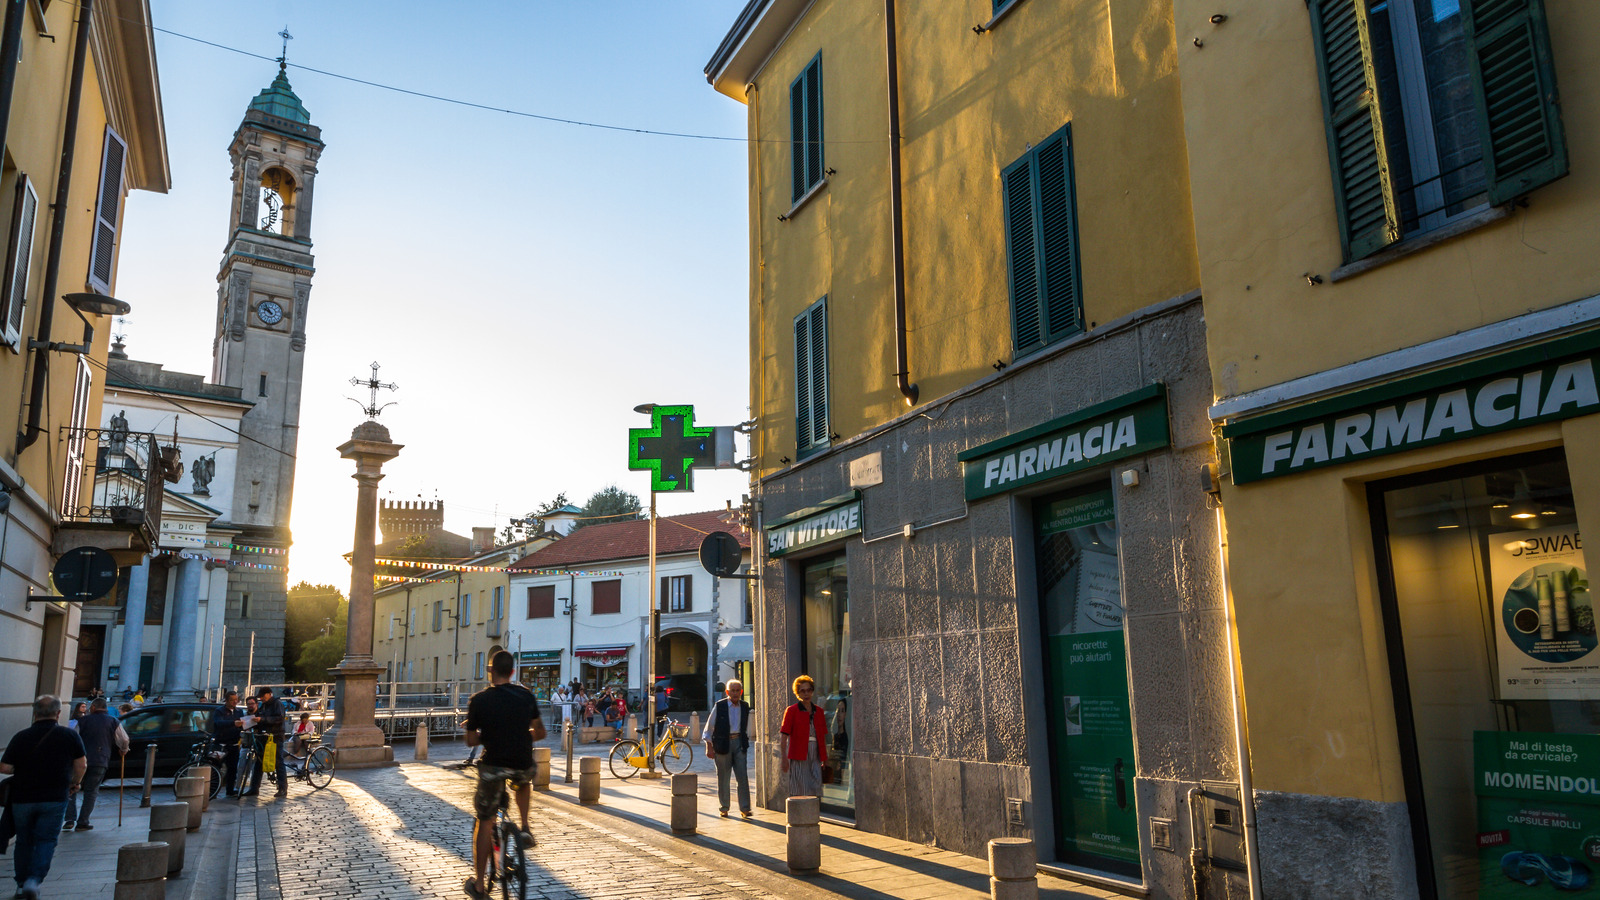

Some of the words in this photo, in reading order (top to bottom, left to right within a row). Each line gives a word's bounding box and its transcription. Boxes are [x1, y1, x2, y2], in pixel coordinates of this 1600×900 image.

[1261, 358, 1600, 475] FARMACIA
[984, 415, 1137, 489] FARMACIA
[1056, 506, 1075, 518] BUONI
[1075, 499, 1105, 513] PROPOSITI
[1050, 517, 1073, 528] RIENTRO
[1073, 512, 1091, 524] DALLE
[769, 527, 795, 553] SAN
[798, 505, 859, 545] VITTORE
[1072, 640, 1108, 651] nicorette
[1070, 653, 1084, 665] può
[1085, 651, 1112, 662] aiutarti
[1509, 741, 1529, 751] Mal
[1531, 742, 1542, 751] di
[1545, 743, 1573, 752] testa
[1505, 751, 1518, 760] da
[1521, 751, 1578, 762] cervicale?
[1484, 771, 1600, 795] MOMENDOL
[1507, 815, 1550, 827] CAPSULE
[1551, 819, 1581, 830] MOLLI
[1092, 831, 1121, 844] nicorette
[1480, 832, 1503, 844] NOVITÀ
